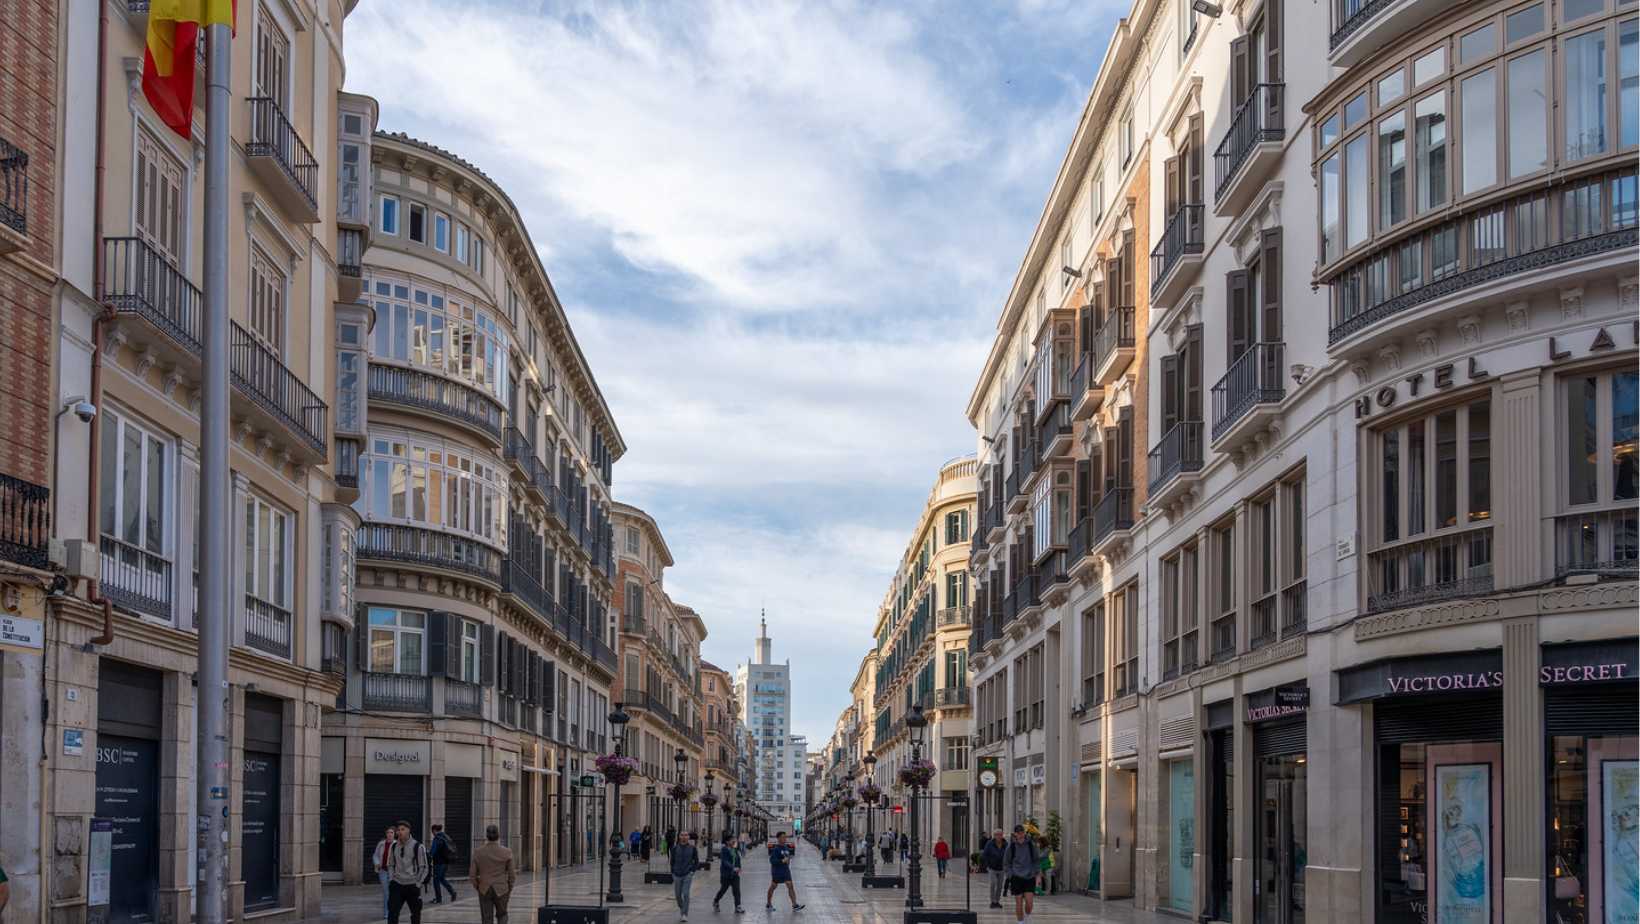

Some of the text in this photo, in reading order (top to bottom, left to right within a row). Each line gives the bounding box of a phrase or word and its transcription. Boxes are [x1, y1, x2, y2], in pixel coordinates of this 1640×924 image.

[1354, 320, 1638, 419] HOTEL LA
[1387, 663, 1627, 693] VICTORIA'S SECRET
